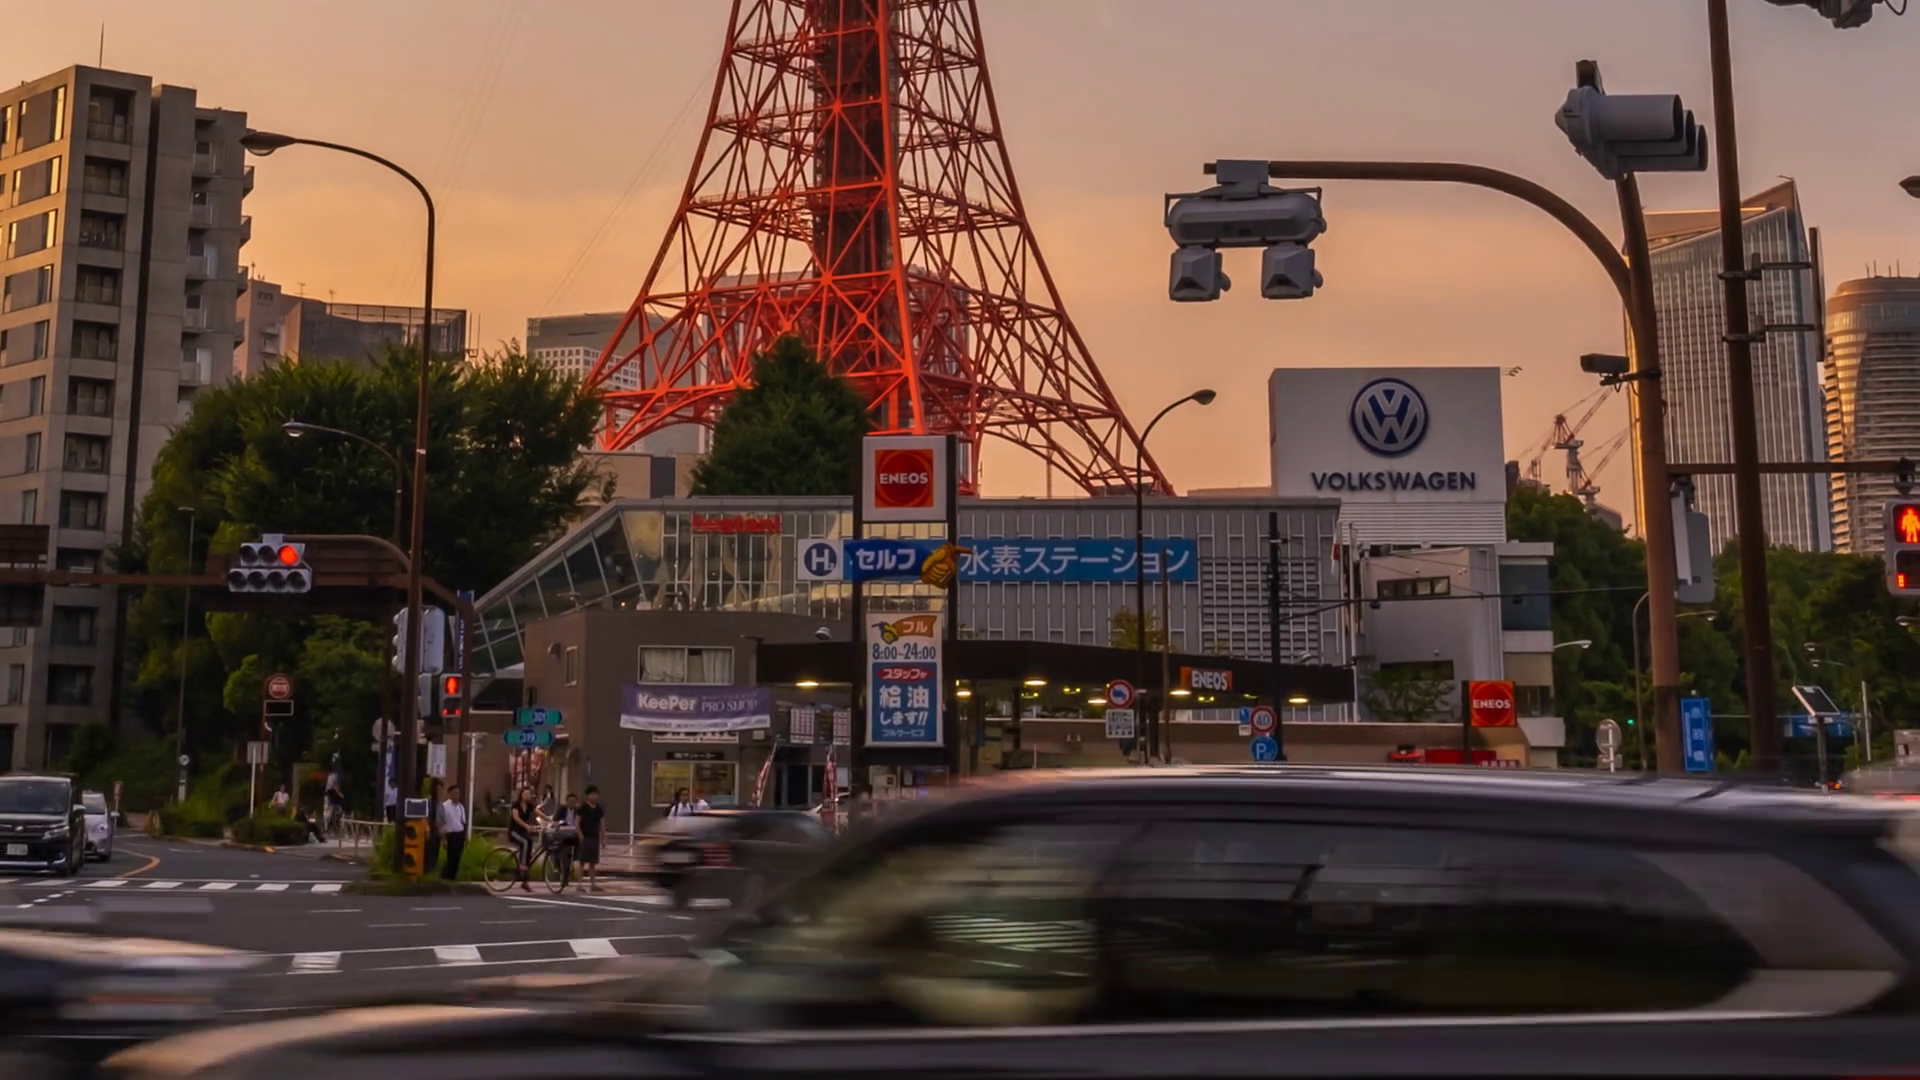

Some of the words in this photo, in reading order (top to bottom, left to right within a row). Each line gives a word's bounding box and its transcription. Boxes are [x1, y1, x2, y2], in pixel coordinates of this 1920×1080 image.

[879, 472, 928, 485] ENEOS
[1311, 471, 1476, 491] VOLKSWAGEN
[855, 548, 915, 570] セルフ
[960, 545, 1190, 575] 水素ステーション
[902, 620, 928, 633] フル
[1191, 670, 1228, 690] ENEOS
[637, 693, 697, 711] KeePer
[701, 700, 725, 712] PRO
[727, 699, 758, 712] SHOP
[879, 685, 929, 709] 給油
[1473, 698, 1510, 709] ENEOS
[521, 733, 536, 742] 319
